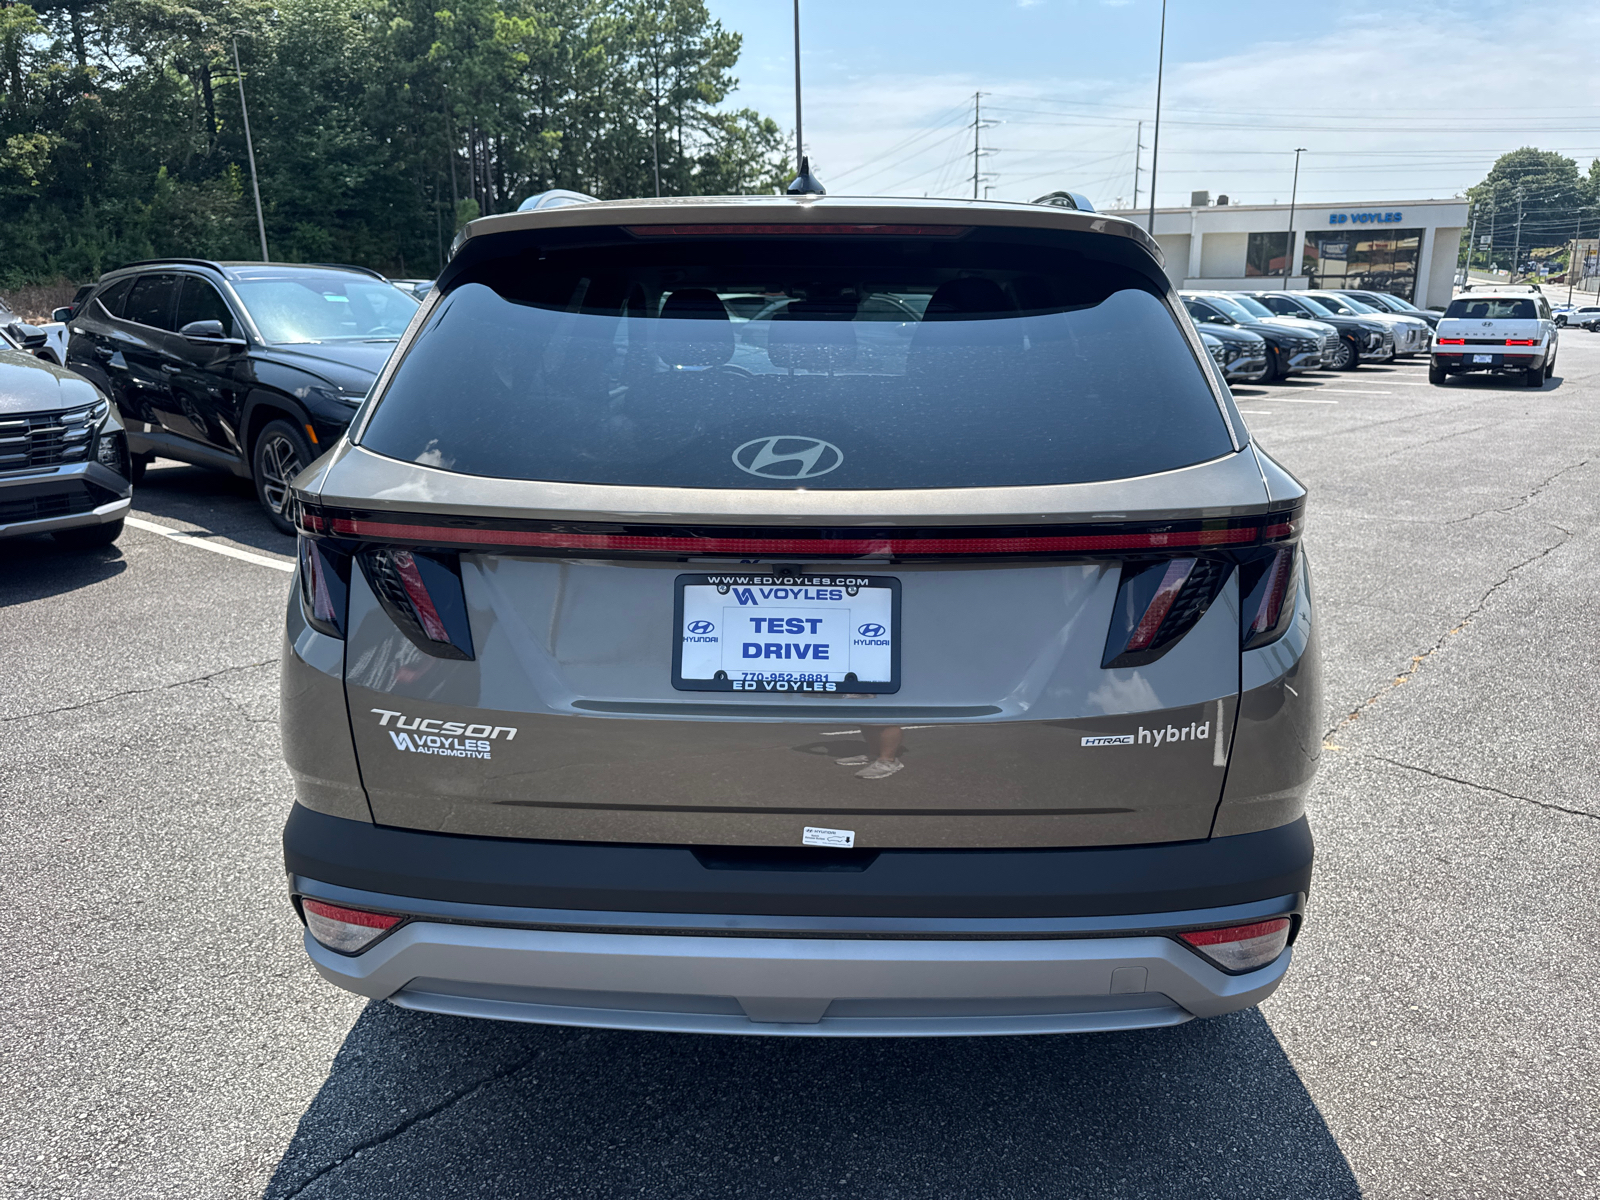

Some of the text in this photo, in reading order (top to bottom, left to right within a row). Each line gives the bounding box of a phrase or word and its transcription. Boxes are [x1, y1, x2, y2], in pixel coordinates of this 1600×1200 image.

[1329, 212, 1402, 224] ED VOYLES
[707, 576, 869, 586] WWW.EDVOYLES.COM
[759, 588, 843, 601] VOYLES
[749, 617, 823, 635] TEST
[742, 642, 830, 660] DRIVE
[741, 672, 829, 682] 770-952-8881
[732, 681, 837, 692] ED VOYLES
[1085, 721, 1210, 747] HTRAC hybrid
[413, 734, 491, 751] VOYLES
[416, 746, 492, 760] AUTOMOTIVE
